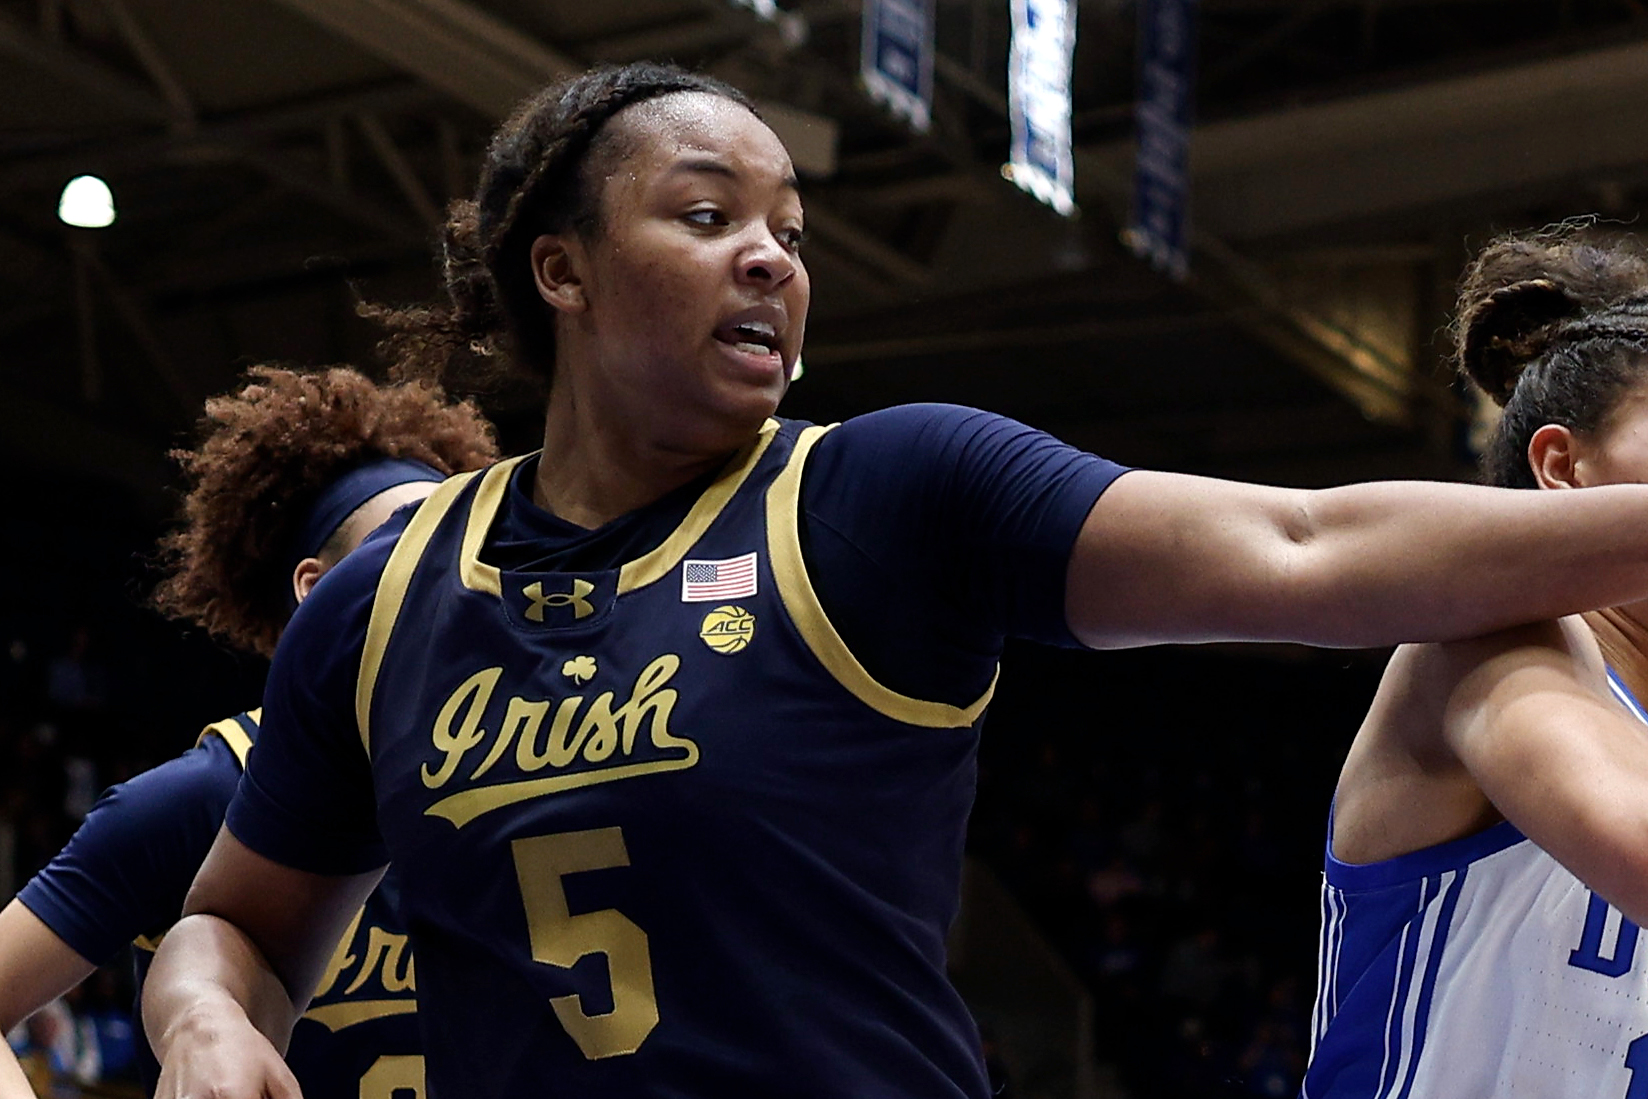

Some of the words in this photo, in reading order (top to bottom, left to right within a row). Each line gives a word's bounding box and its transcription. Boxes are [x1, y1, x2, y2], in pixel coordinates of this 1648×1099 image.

[706, 617, 754, 632] ACC
[420, 653, 700, 790] Irish
[510, 826, 660, 1060] 5
